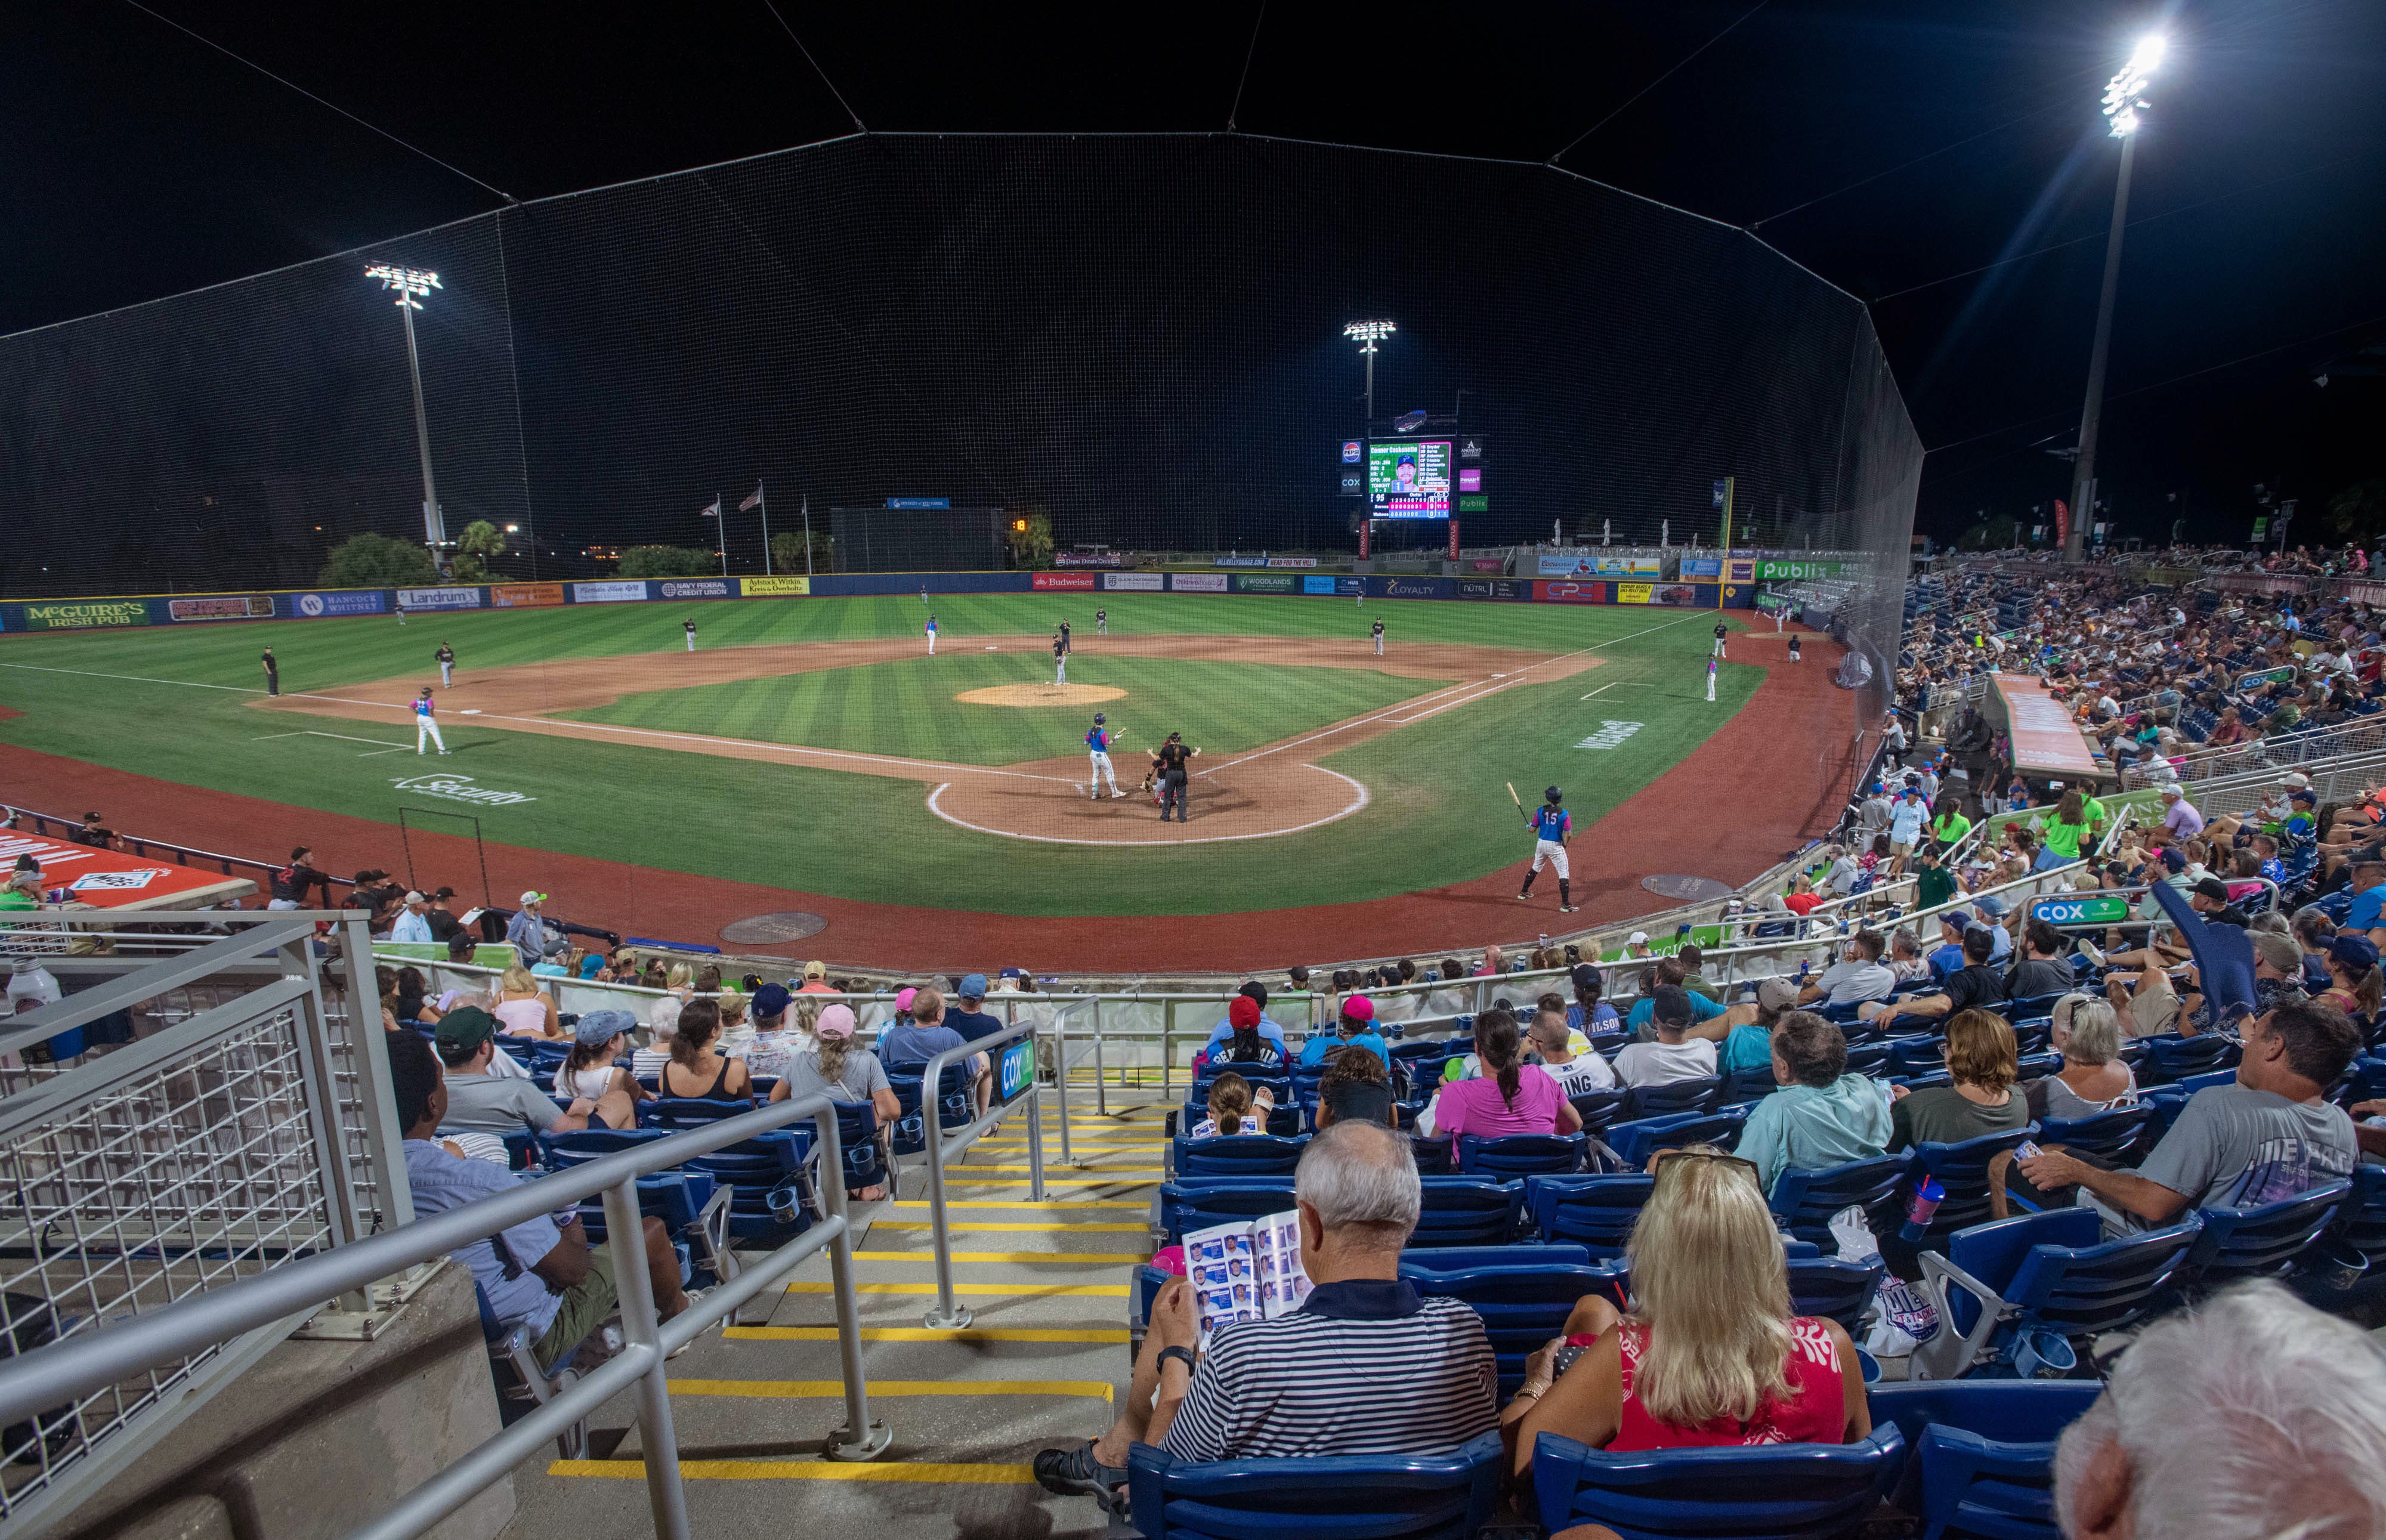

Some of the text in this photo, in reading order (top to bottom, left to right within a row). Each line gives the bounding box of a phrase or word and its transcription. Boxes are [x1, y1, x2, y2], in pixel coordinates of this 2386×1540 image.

[1342, 478, 1360, 487] COX
[1764, 563, 1827, 578] Publix
[1395, 586, 1434, 596] LOYALTY
[327, 595, 376, 604] HANCOCK
[411, 592, 465, 604] Landrum
[329, 603, 377, 611] WHITNEY
[48, 616, 130, 627] IRISH PUB
[2244, 676, 2267, 686] COX
[2038, 904, 2085, 921] COX
[1004, 1053, 1021, 1090] COX
[1560, 1075, 1591, 1096] ING
